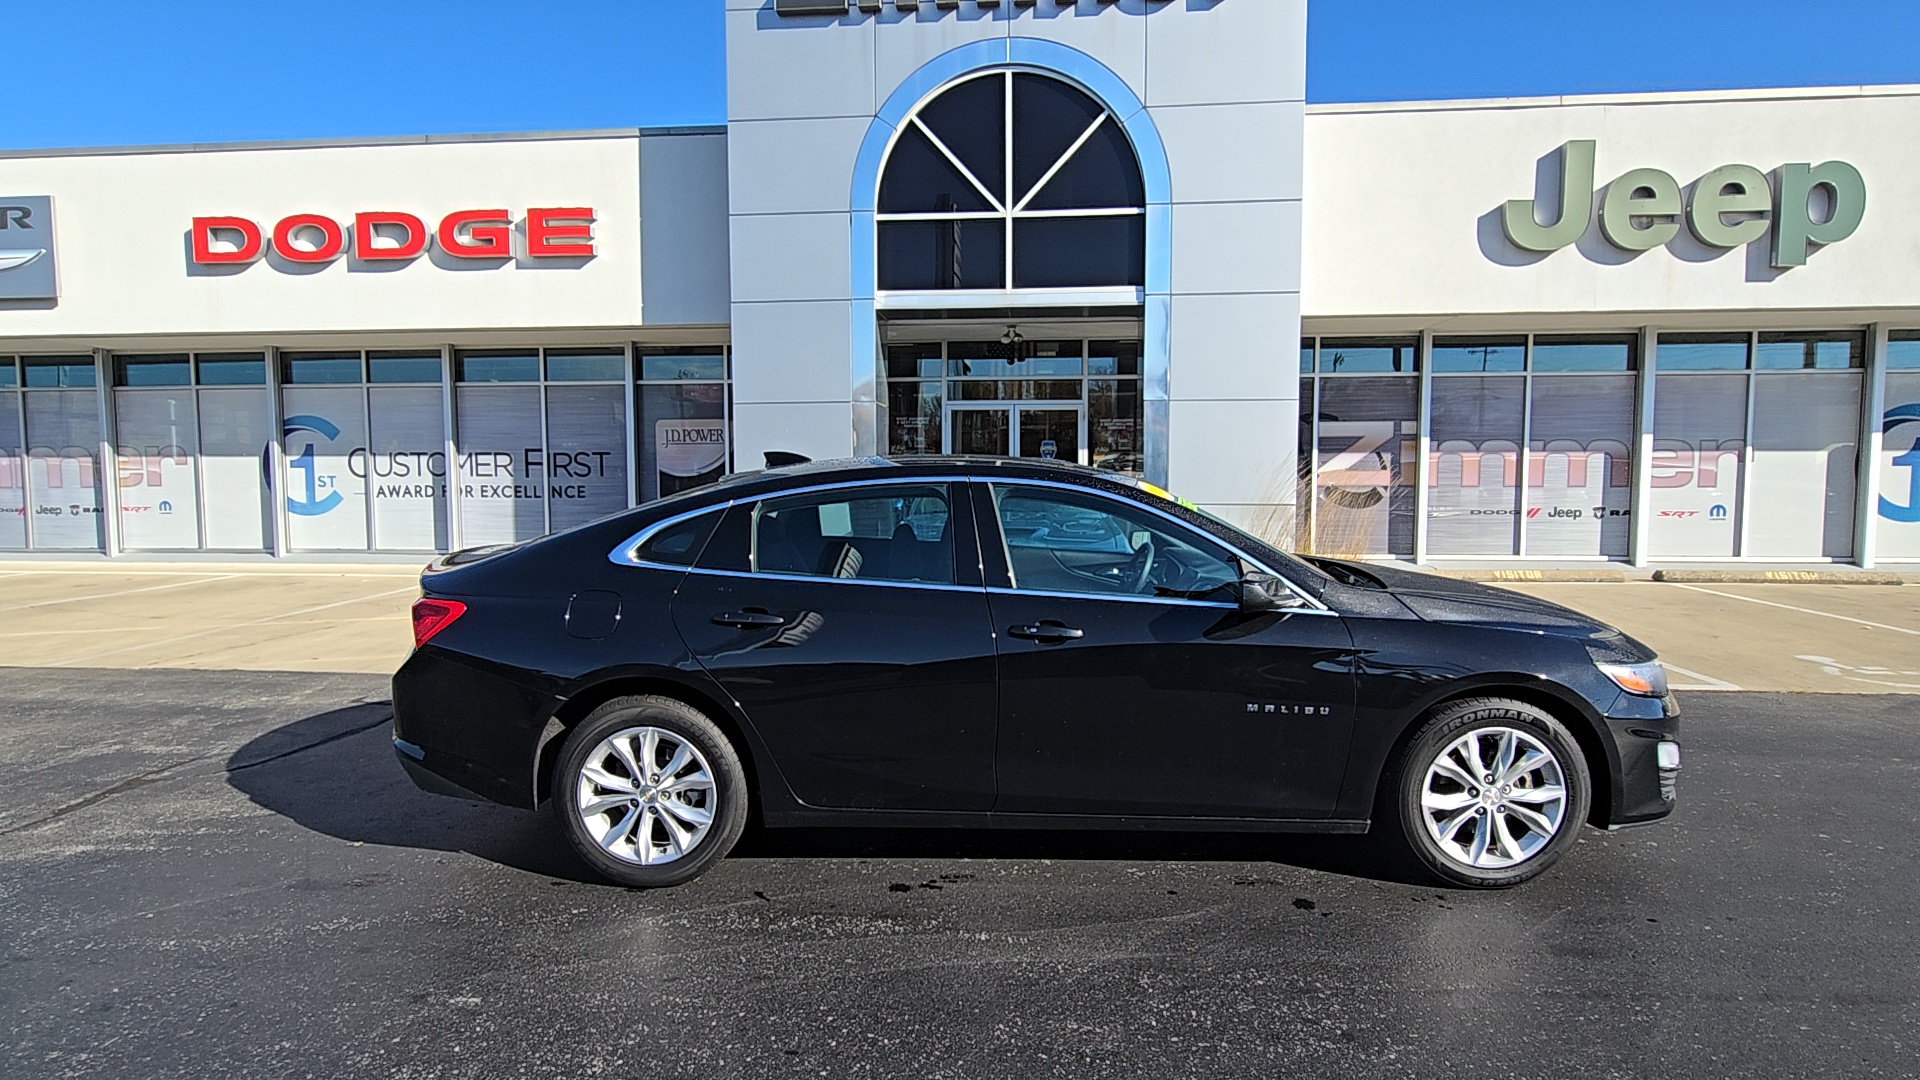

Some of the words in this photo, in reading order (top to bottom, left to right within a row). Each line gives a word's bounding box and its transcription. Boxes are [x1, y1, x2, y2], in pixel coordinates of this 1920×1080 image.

[1505, 140, 1866, 267] Jeep
[191, 207, 598, 263] DODGE
[347, 447, 514, 478] CUSTOMER
[523, 447, 611, 478] FIRST
[376, 484, 435, 498] AWARD
[441, 484, 474, 498] FR
[480, 484, 586, 498] EXCELLNCE
[35, 505, 63, 516] Jeep
[1548, 506, 1583, 520] Jeep
[1656, 510, 1700, 519] SRT
[1493, 570, 1543, 579] VISITOR
[1246, 703, 1330, 715] MALIBU
[1442, 708, 1534, 734] IRONMAN
